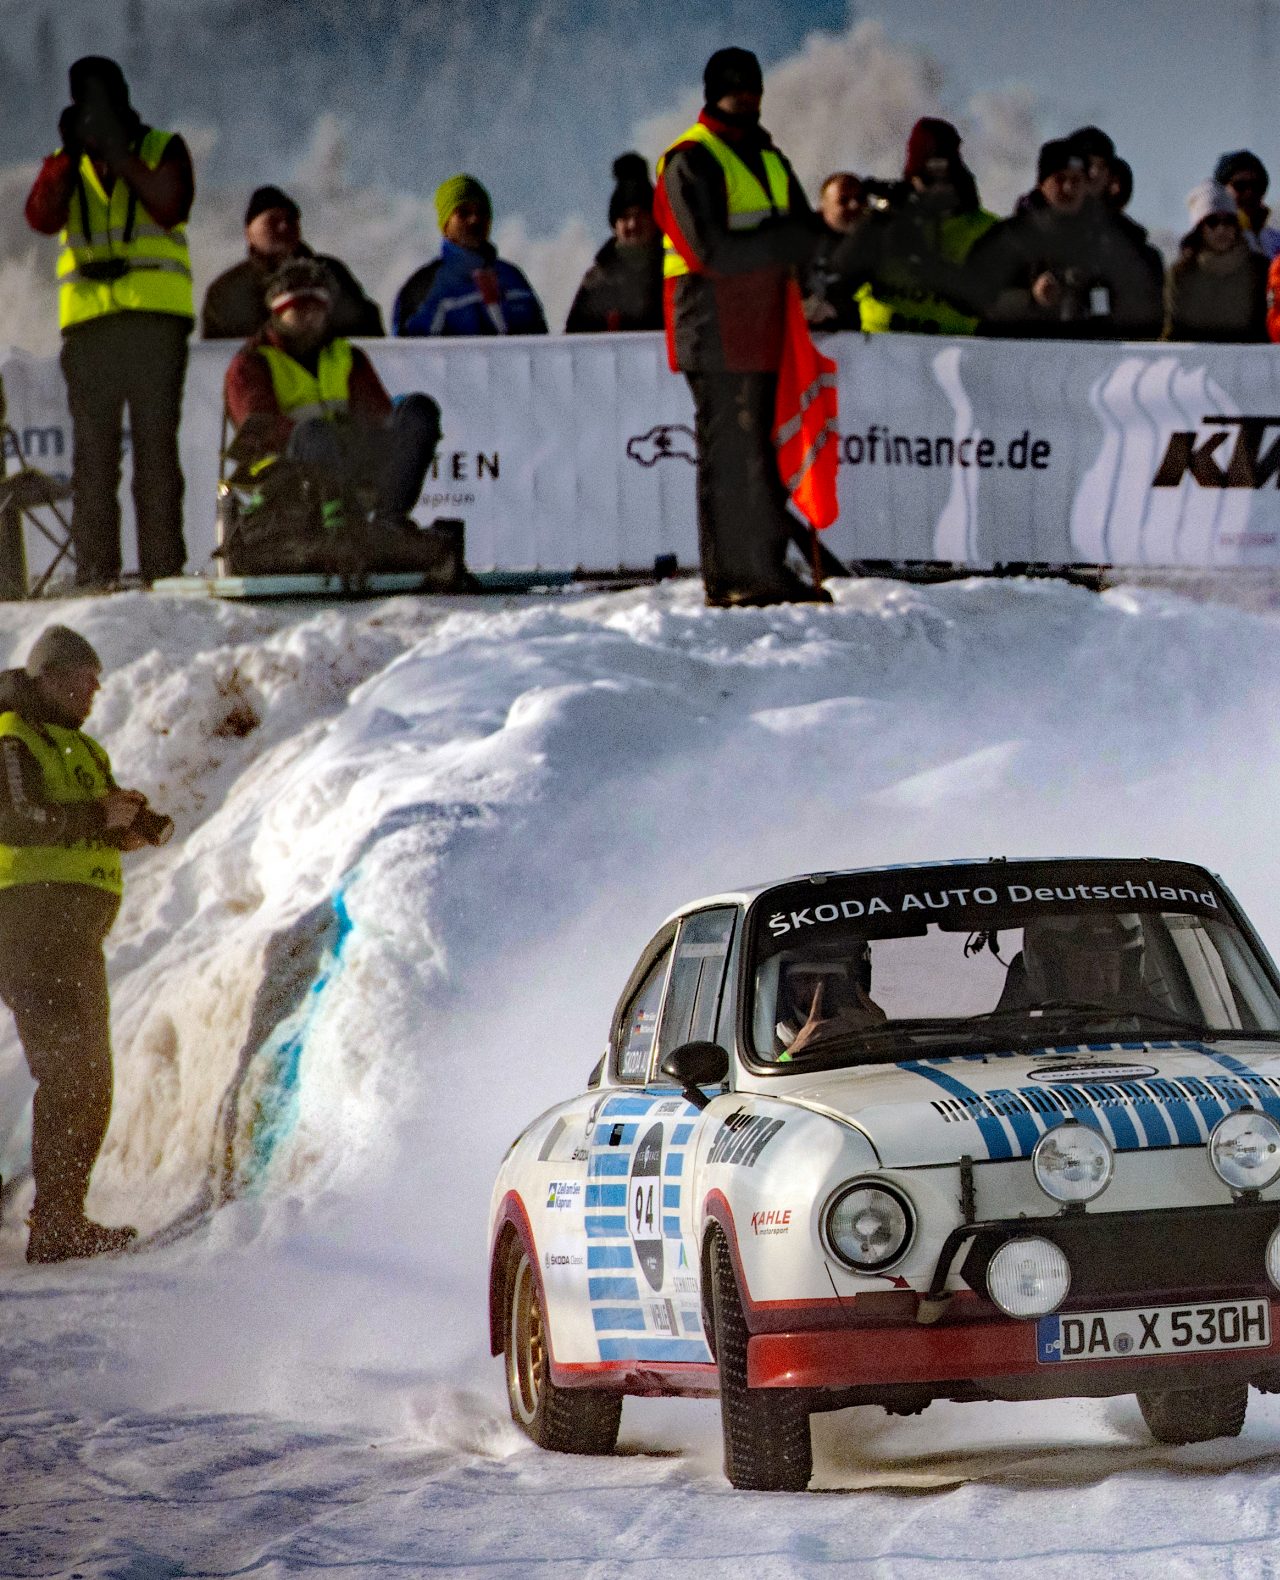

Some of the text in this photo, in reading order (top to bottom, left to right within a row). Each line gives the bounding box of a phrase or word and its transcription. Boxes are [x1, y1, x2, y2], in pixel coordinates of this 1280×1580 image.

[768, 880, 1219, 937] ŠKODA AUTO Deutschland
[635, 1184, 654, 1234] 94
[751, 1210, 792, 1236] KAHLE
[760, 1227, 789, 1236] motorsport
[1062, 1304, 1266, 1355] DA X 530H
